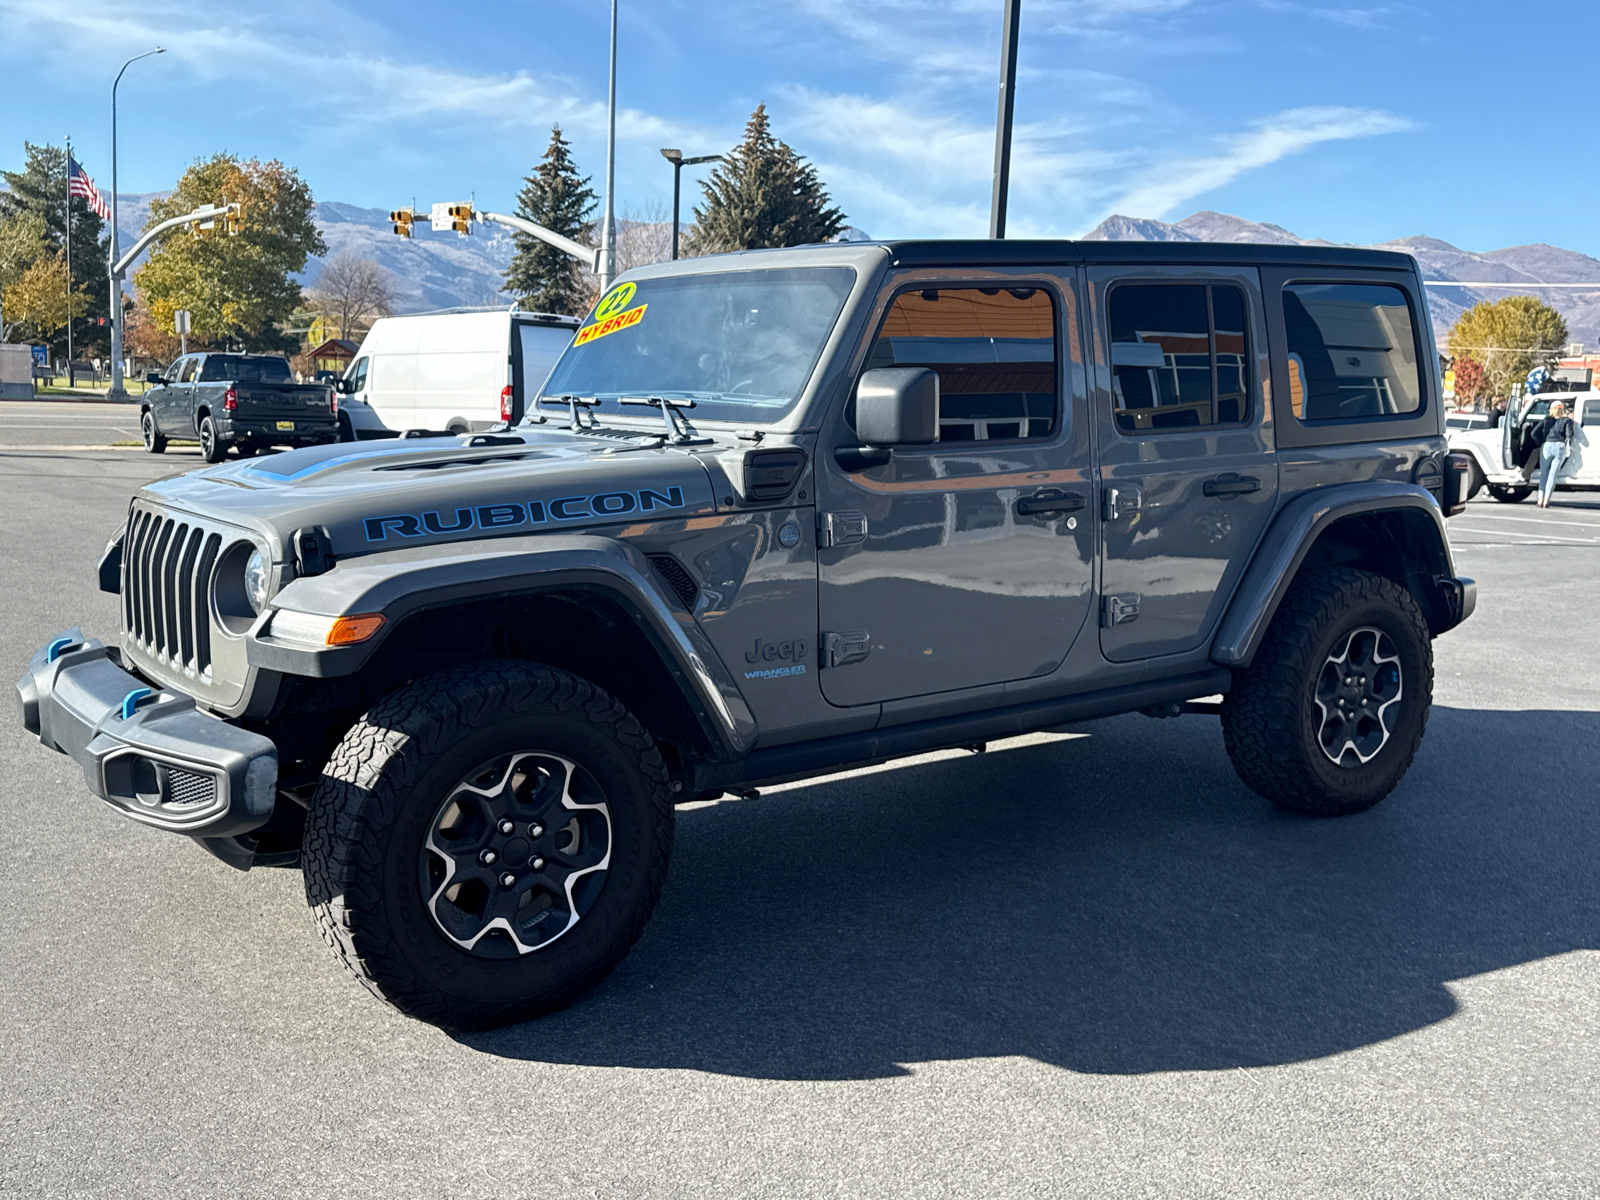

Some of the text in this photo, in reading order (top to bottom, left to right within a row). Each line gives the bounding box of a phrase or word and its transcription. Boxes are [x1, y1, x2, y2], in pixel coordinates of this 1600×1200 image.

[600, 285, 631, 317] 22
[575, 308, 643, 345] HYBRID
[362, 485, 686, 542] RUBICON
[744, 638, 808, 664] Jeep
[744, 664, 806, 679] WRANGLER
